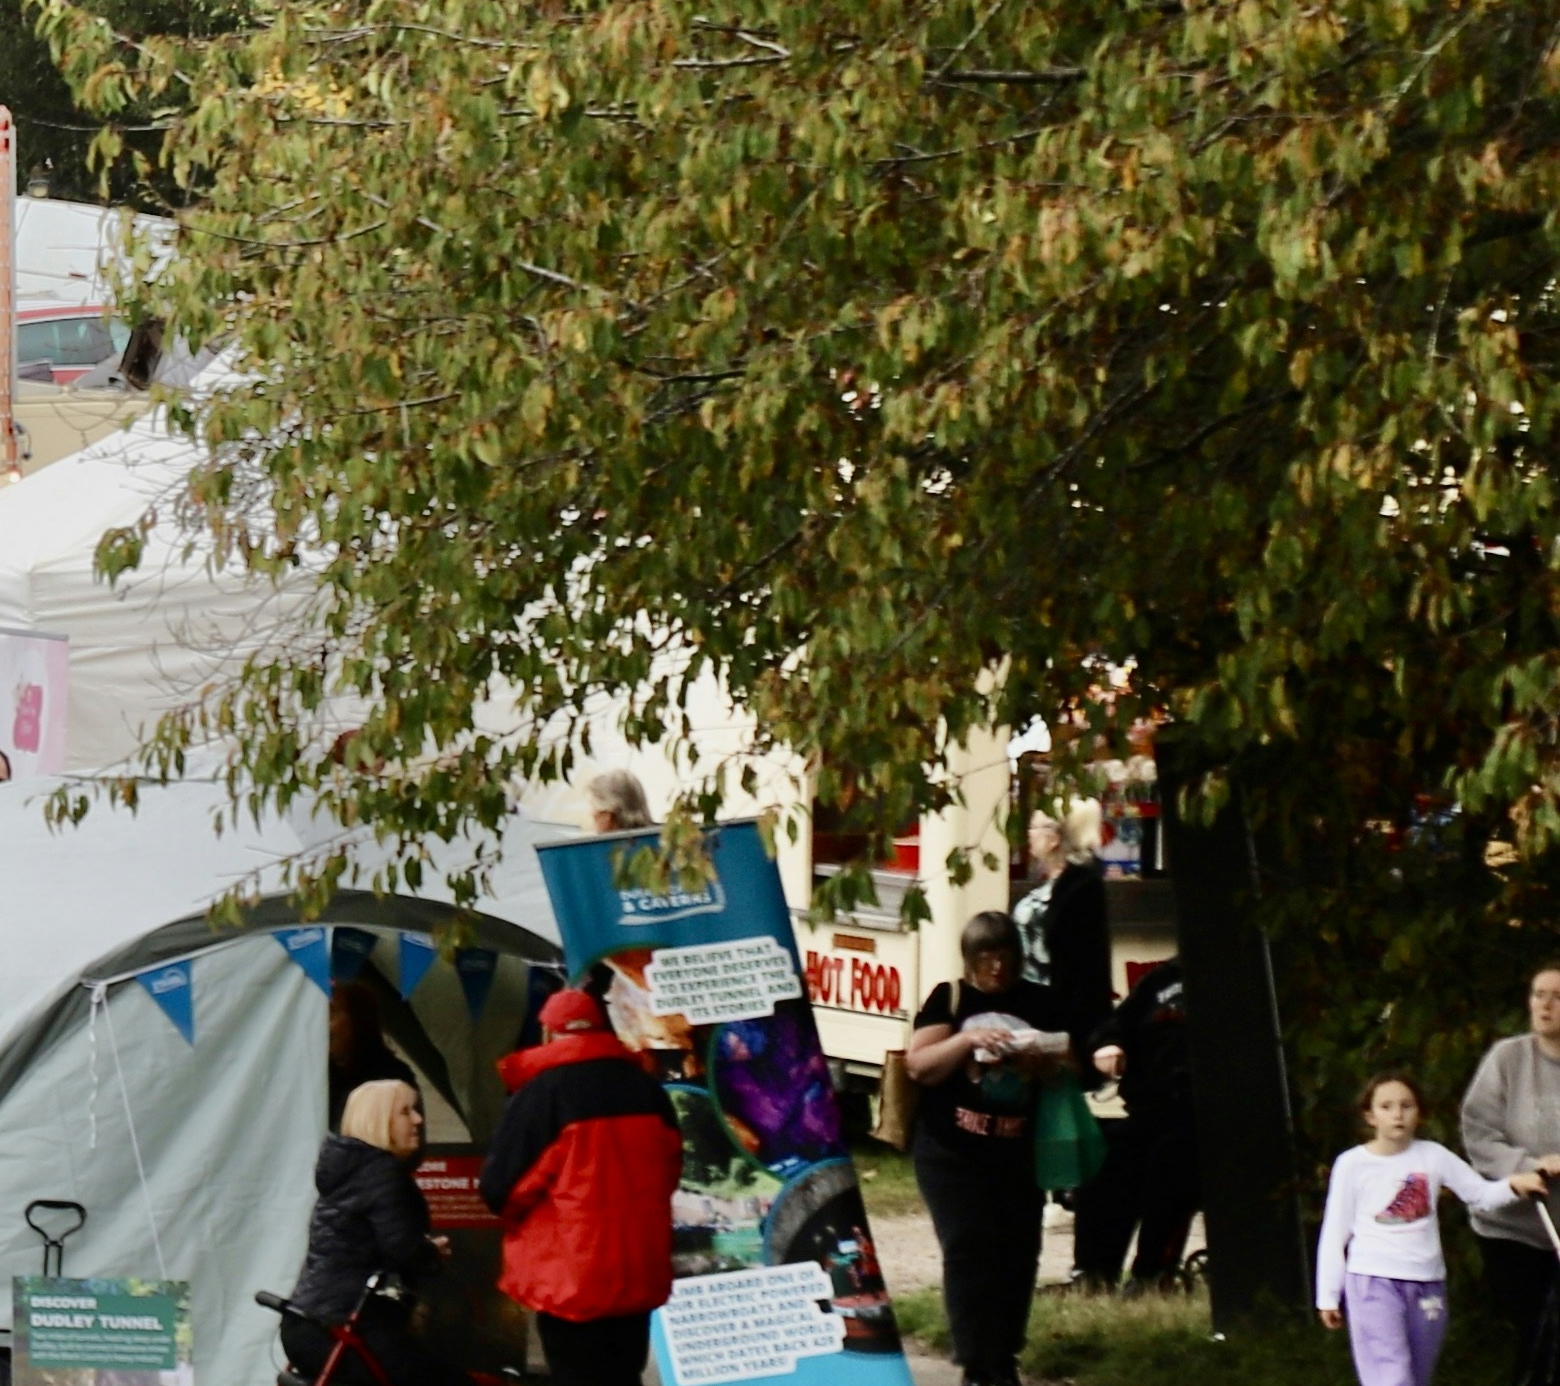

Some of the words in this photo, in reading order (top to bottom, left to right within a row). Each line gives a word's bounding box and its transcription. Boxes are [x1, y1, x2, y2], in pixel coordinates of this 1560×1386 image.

[805, 950, 843, 1005] HOT
[851, 958, 901, 1013] FOOD
[415, 1177, 469, 1190] ESTONE
[30, 1296, 97, 1310] DISCOVER
[30, 1313, 95, 1329] DUDLEY
[98, 1315, 164, 1331] TUNNEL
